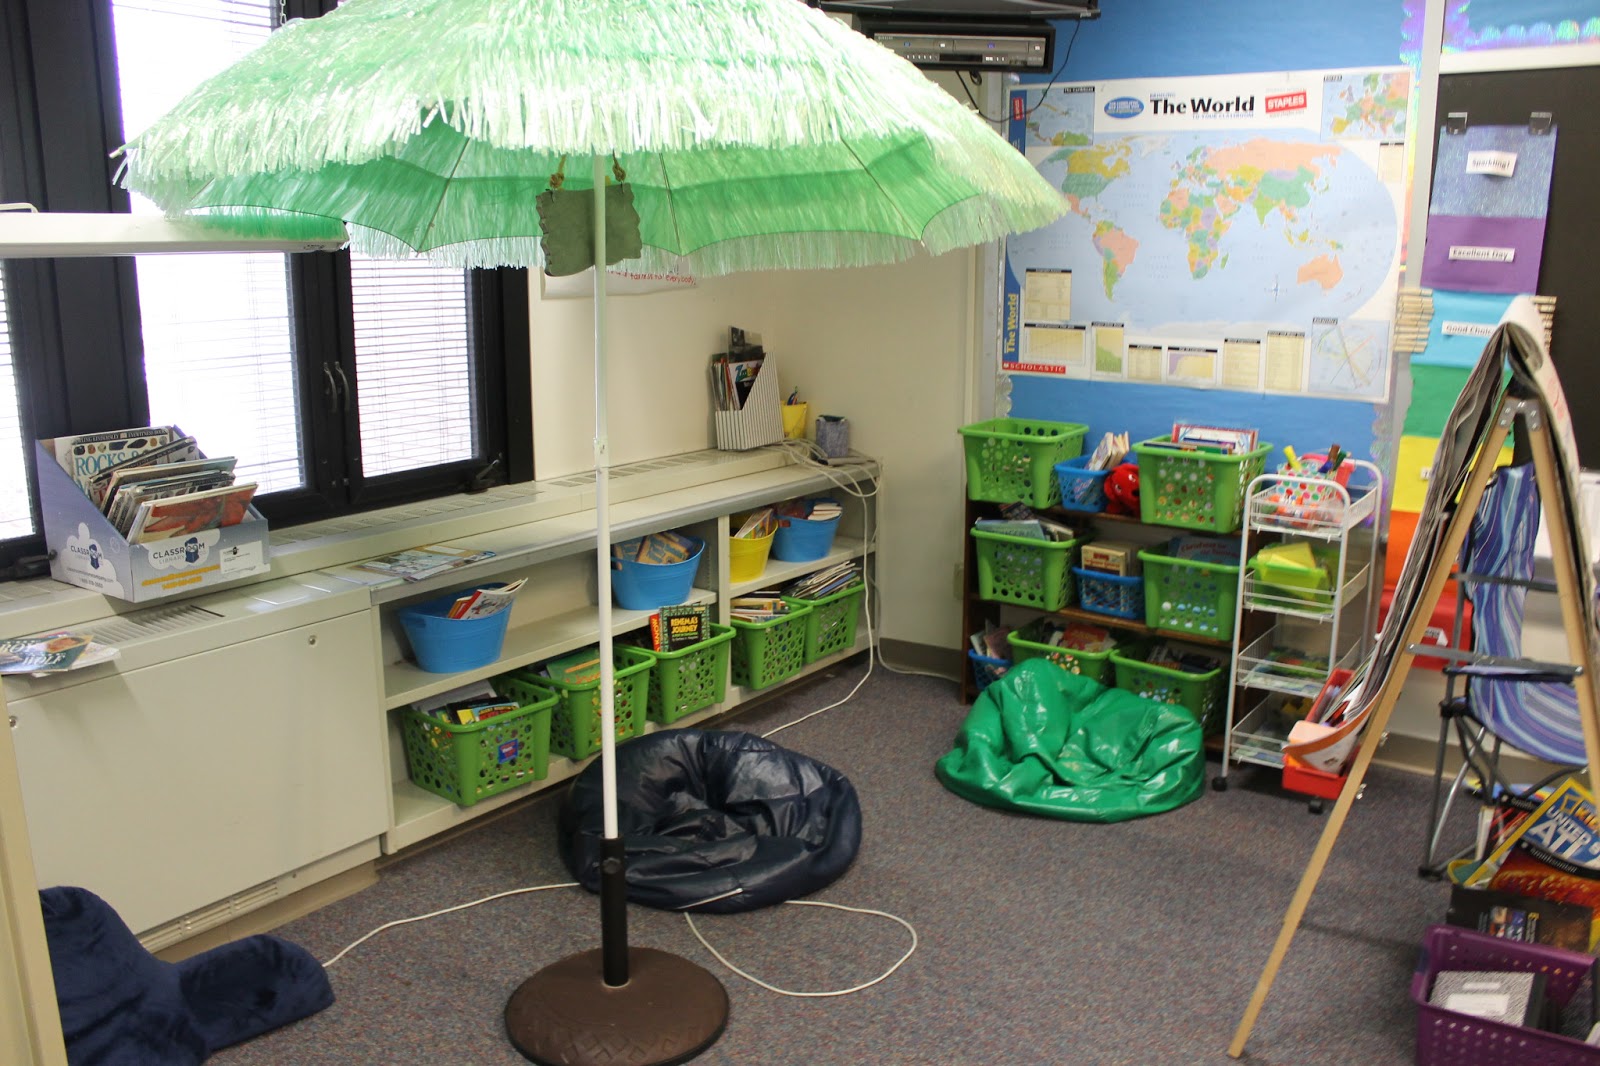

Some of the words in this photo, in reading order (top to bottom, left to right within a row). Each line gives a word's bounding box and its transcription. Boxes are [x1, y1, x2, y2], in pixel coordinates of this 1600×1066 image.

[1150, 98, 1187, 115] The
[1190, 95, 1255, 114] World
[1267, 94, 1305, 110] STAPLES
[1452, 249, 1490, 258] Excellent
[1491, 250, 1509, 262] Day
[1007, 293, 1017, 331] World
[1446, 324, 1469, 333] Good
[1470, 325, 1494, 336] Choic
[1006, 331, 1016, 354] The
[1010, 362, 1065, 373] SCHOLASTIC
[75, 451, 126, 477] ROCKS
[153, 543, 205, 559] CLASSROOM
[671, 624, 698, 634] JOURNEY
[1546, 804, 1592, 846] UNITED
